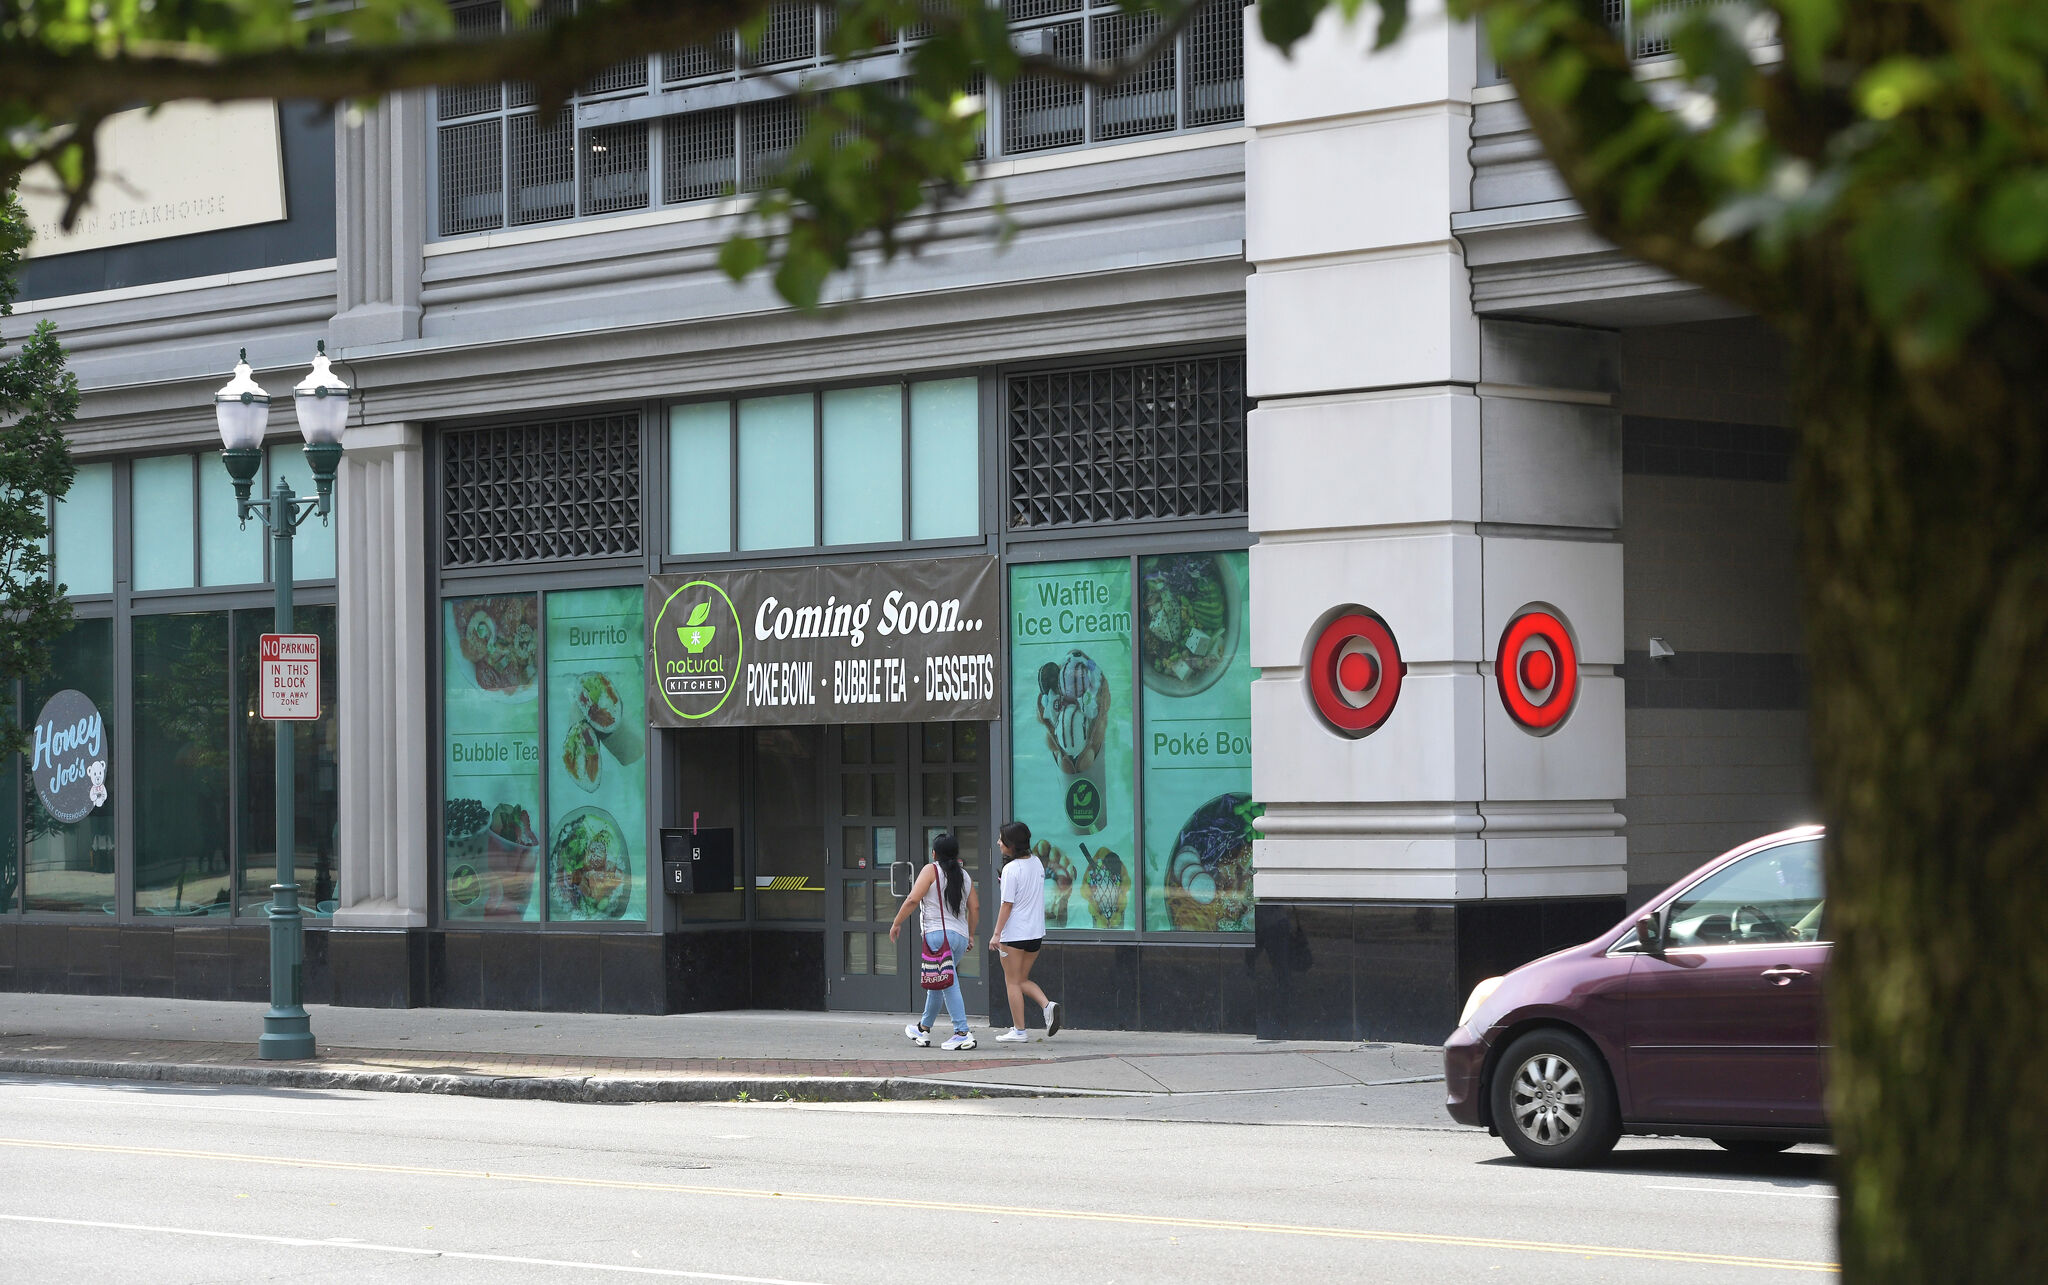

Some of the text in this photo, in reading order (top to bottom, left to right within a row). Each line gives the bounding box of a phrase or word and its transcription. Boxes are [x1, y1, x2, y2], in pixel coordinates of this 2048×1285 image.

[110, 195, 225, 231] STEAKHOUSE
[1038, 580, 1110, 607] Waffle
[754, 590, 983, 648] Coming Soon...
[1018, 609, 1131, 637] Ice Cream
[569, 624, 628, 647] Burrito
[263, 640, 316, 657] NO PARKING
[271, 664, 309, 676] IN THIS
[666, 655, 724, 674] natural
[274, 677, 306, 688] BLOCK
[670, 681, 720, 690] KITCHEN
[746, 653, 994, 707] POKE BOWL BUBBLE TEA DESSERTS
[32, 711, 101, 772] Honey
[452, 741, 540, 763] Bubble Tea
[1154, 731, 1209, 756] Poké
[50, 757, 86, 794] Joe's
